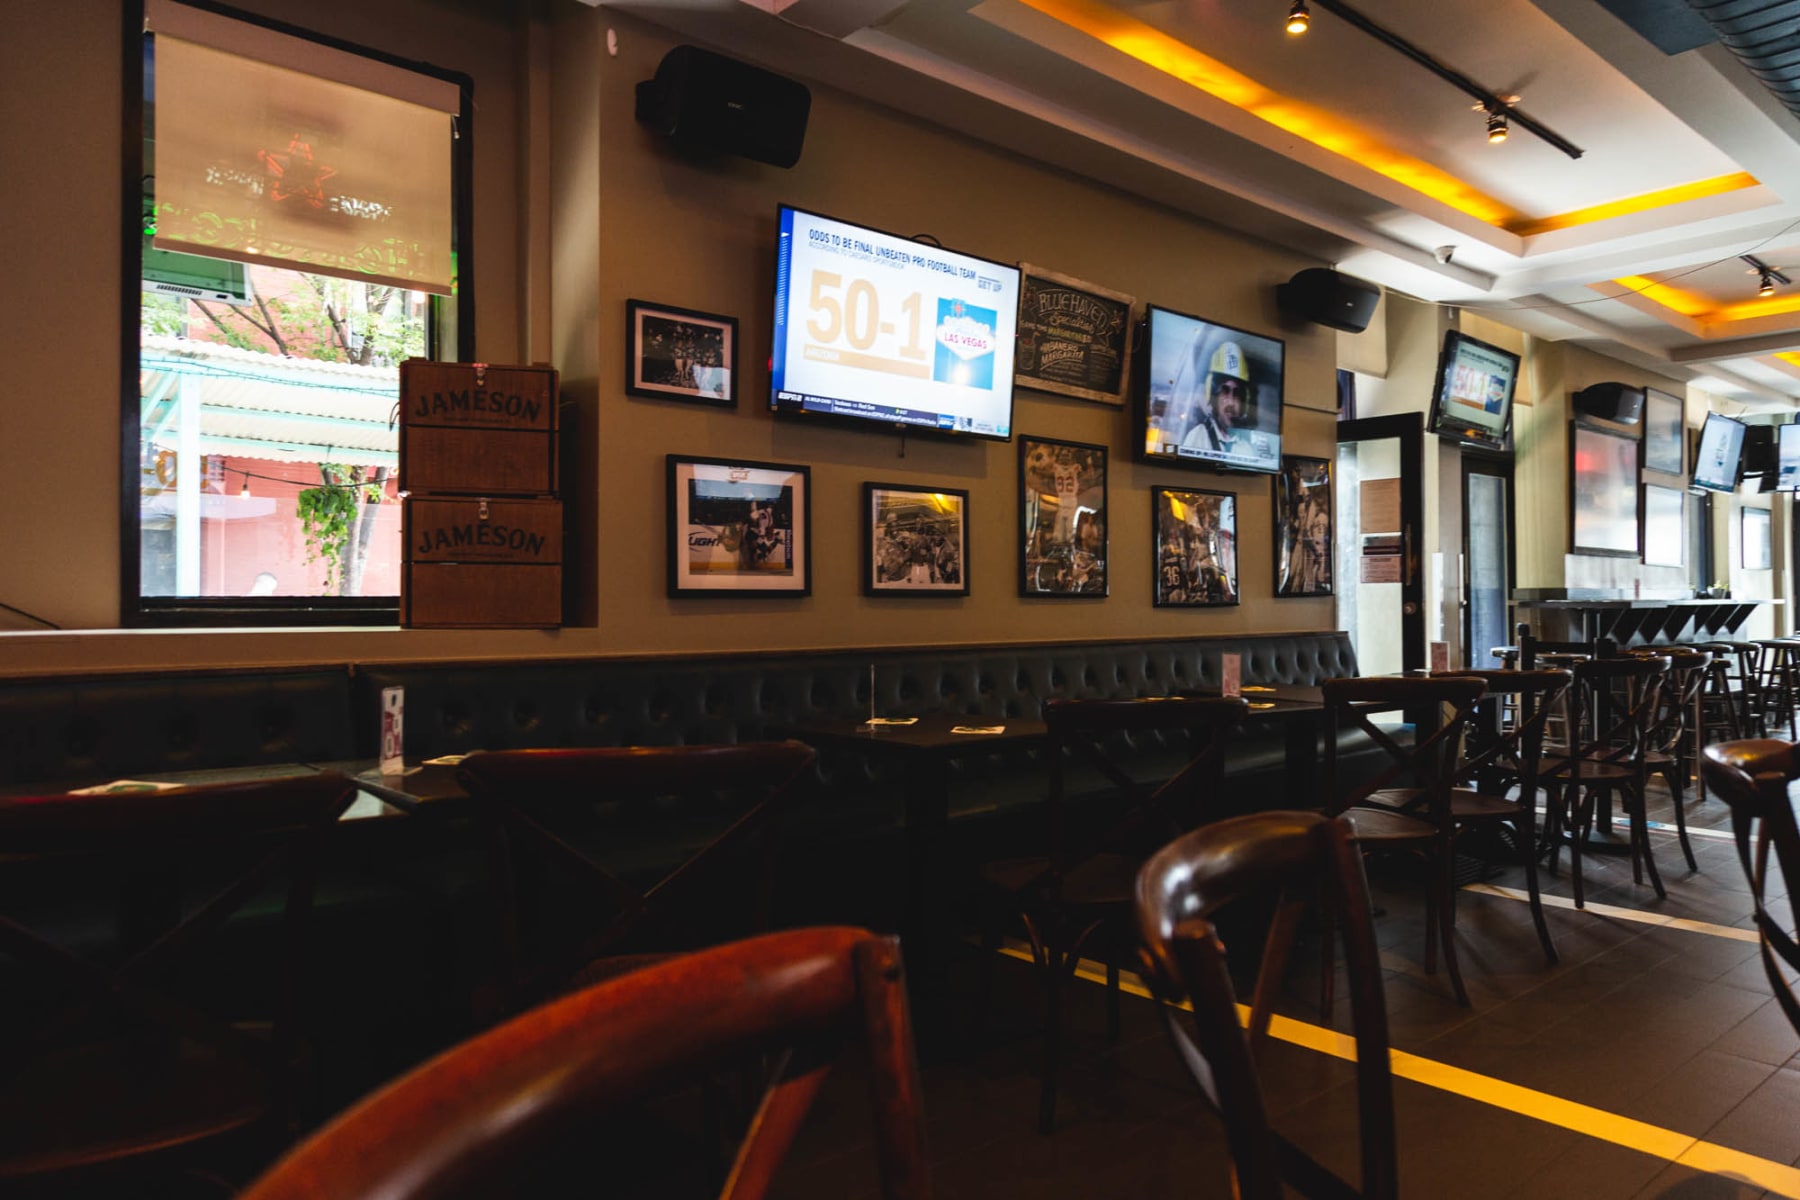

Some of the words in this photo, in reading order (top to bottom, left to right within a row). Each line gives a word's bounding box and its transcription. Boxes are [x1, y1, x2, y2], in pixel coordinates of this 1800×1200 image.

[809, 229, 830, 243] ODDS
[832, 235, 840, 246] TO
[843, 237, 852, 249] BE
[855, 241, 873, 255] FINAL
[876, 246, 910, 264] UNBEATEN
[913, 255, 925, 268] PRO
[928, 259, 957, 276] FOOTBALL
[960, 267, 976, 279] TEAM
[978, 280, 991, 291] GET
[993, 284, 1003, 293] UP
[806, 269, 927, 360] 50-1
[1039, 293, 1069, 313] BLUE
[1070, 294, 1108, 328] HAVEN
[944, 332, 959, 344] LAS
[961, 336, 988, 350] VEGAS
[416, 390, 540, 423] JAMESON
[418, 521, 545, 556] JAMESON
